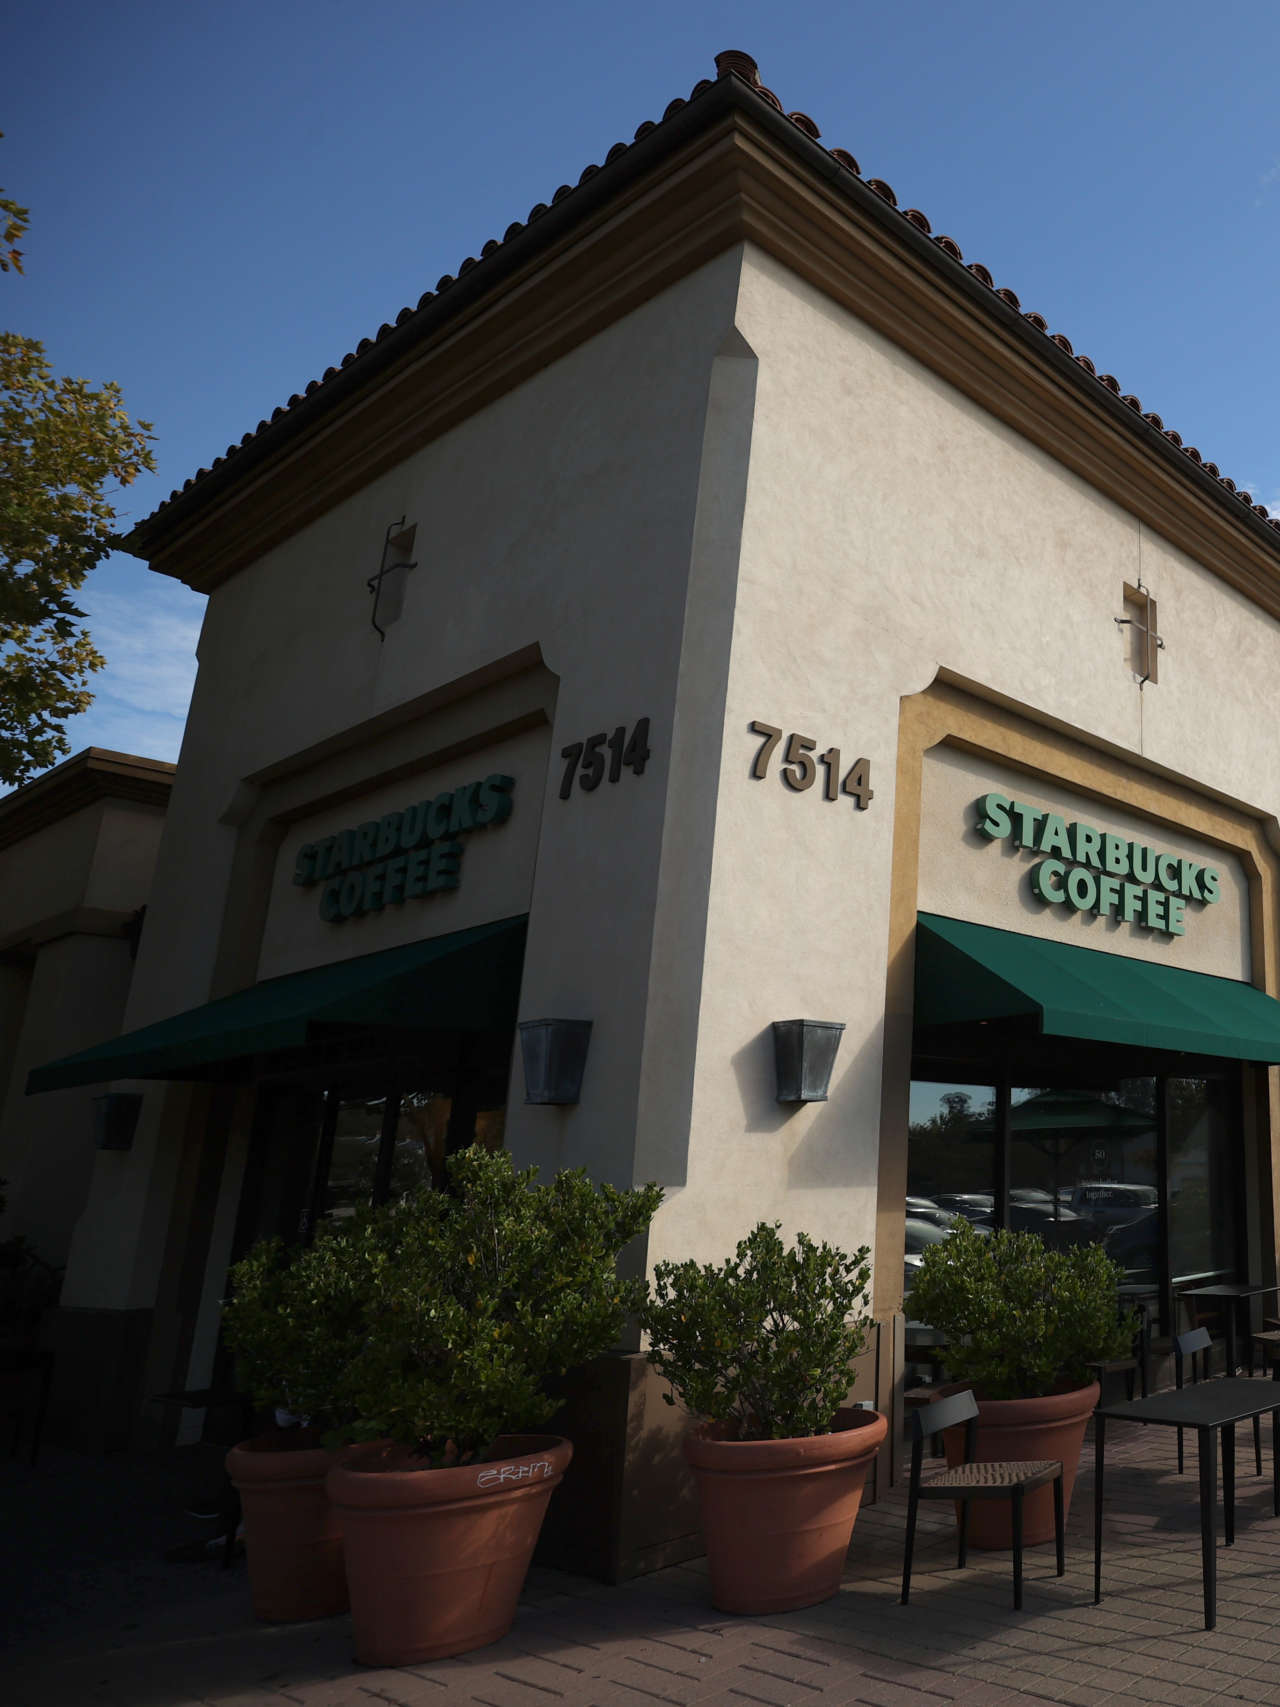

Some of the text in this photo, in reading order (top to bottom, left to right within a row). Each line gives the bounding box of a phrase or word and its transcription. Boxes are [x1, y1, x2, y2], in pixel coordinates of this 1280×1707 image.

[559, 717, 650, 800] 7514
[750, 720, 874, 810] 7514
[293, 773, 516, 888] STARBUCKS
[977, 792, 1222, 906] STARBUCKS
[318, 842, 465, 924] COFFEE
[1031, 857, 1187, 937] COFFEE
